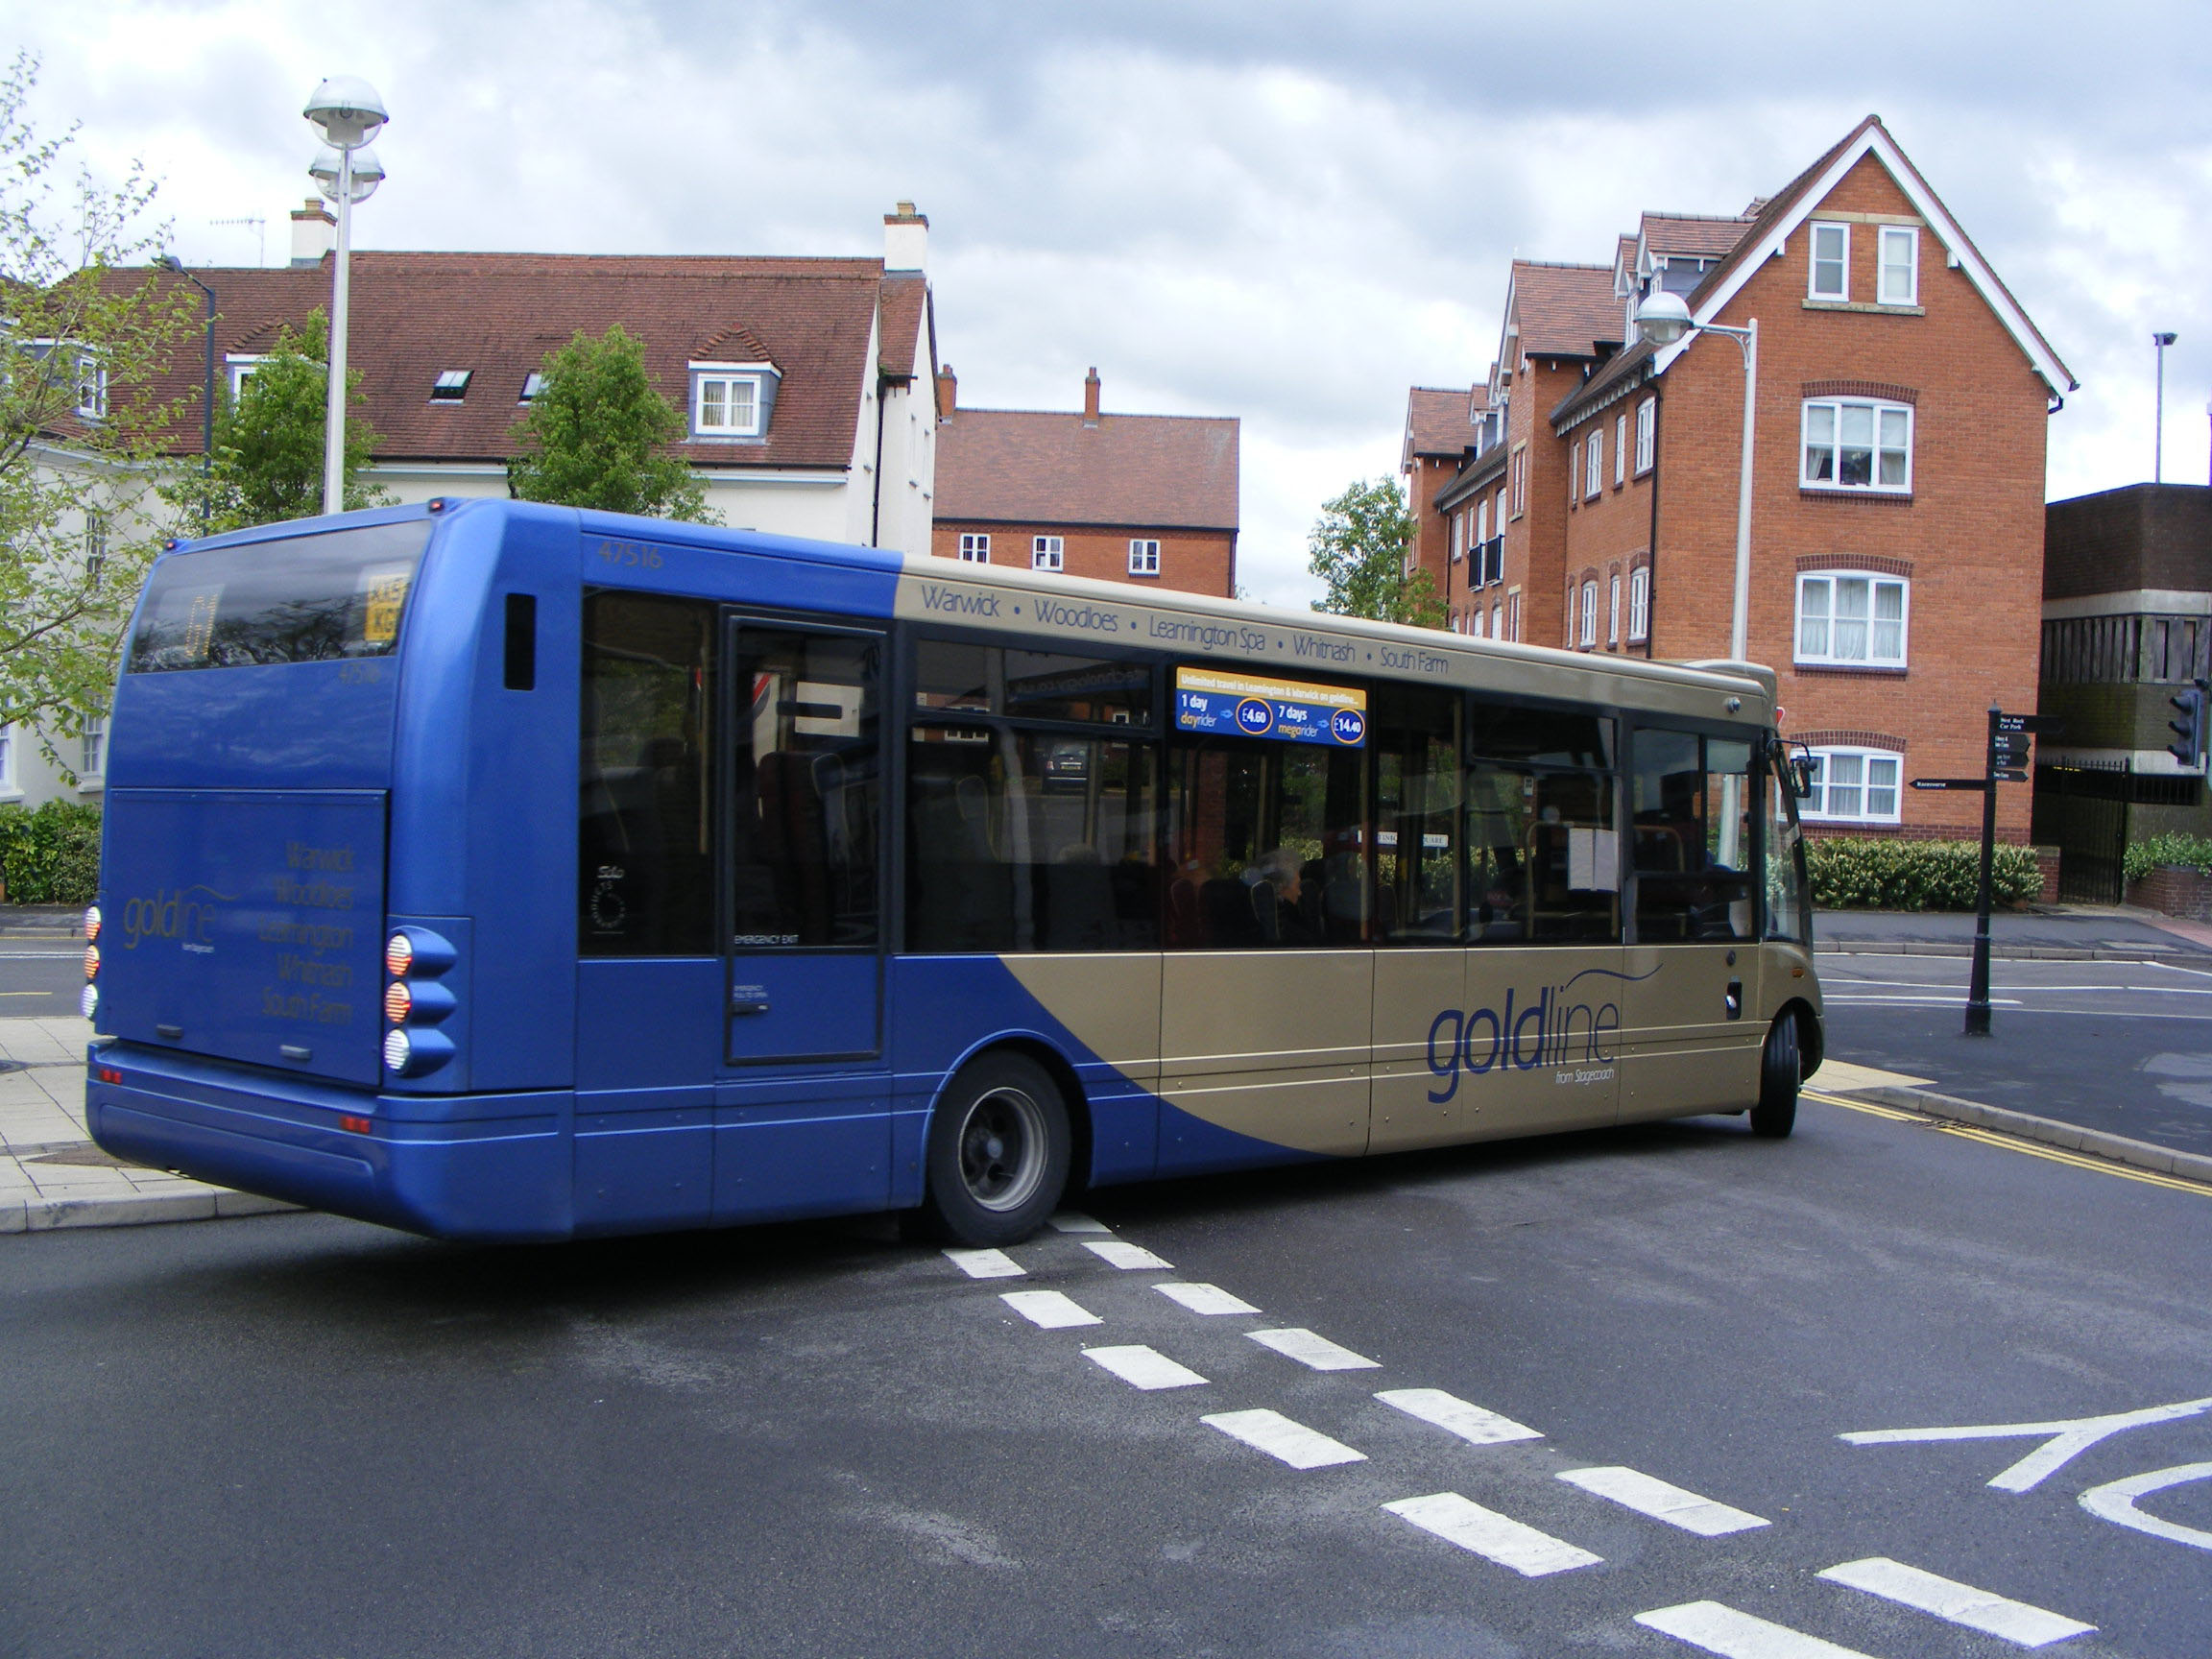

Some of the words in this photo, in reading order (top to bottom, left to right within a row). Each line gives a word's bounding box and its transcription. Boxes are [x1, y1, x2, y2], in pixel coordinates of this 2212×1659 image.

[599, 541, 662, 569] 47516
[922, 584, 1000, 619] Warwick
[1035, 599, 1119, 635] Woodloes
[1150, 614, 1237, 653] Leamington
[1238, 626, 1266, 653] Spa
[1293, 635, 1357, 663] Whitnash
[1381, 646, 1416, 670] South
[1417, 653, 1450, 675] Farm
[1181, 674, 1215, 687] Unlimited
[1216, 679, 1236, 690] travel
[1245, 682, 1285, 699] Leamington
[1182, 694, 1188, 708] 1
[1190, 694, 1208, 712] day
[1241, 708, 1267, 724] £4.60
[1278, 705, 1286, 718] 7
[1286, 706, 1308, 723] days
[1180, 710, 1217, 730] dayrider
[1278, 724, 1319, 739] megarider
[1334, 717, 1362, 733] £14.40
[285, 842, 354, 873] Warwick
[273, 875, 354, 912] Woodloes
[123, 888, 216, 950] goldline
[734, 934, 780, 946] EMERGENCY
[781, 934, 799, 945] EXIT
[1427, 985, 1620, 1104] goldline
[1555, 1070, 1574, 1084] from
[1575, 1067, 1615, 1085] Stagecoach
